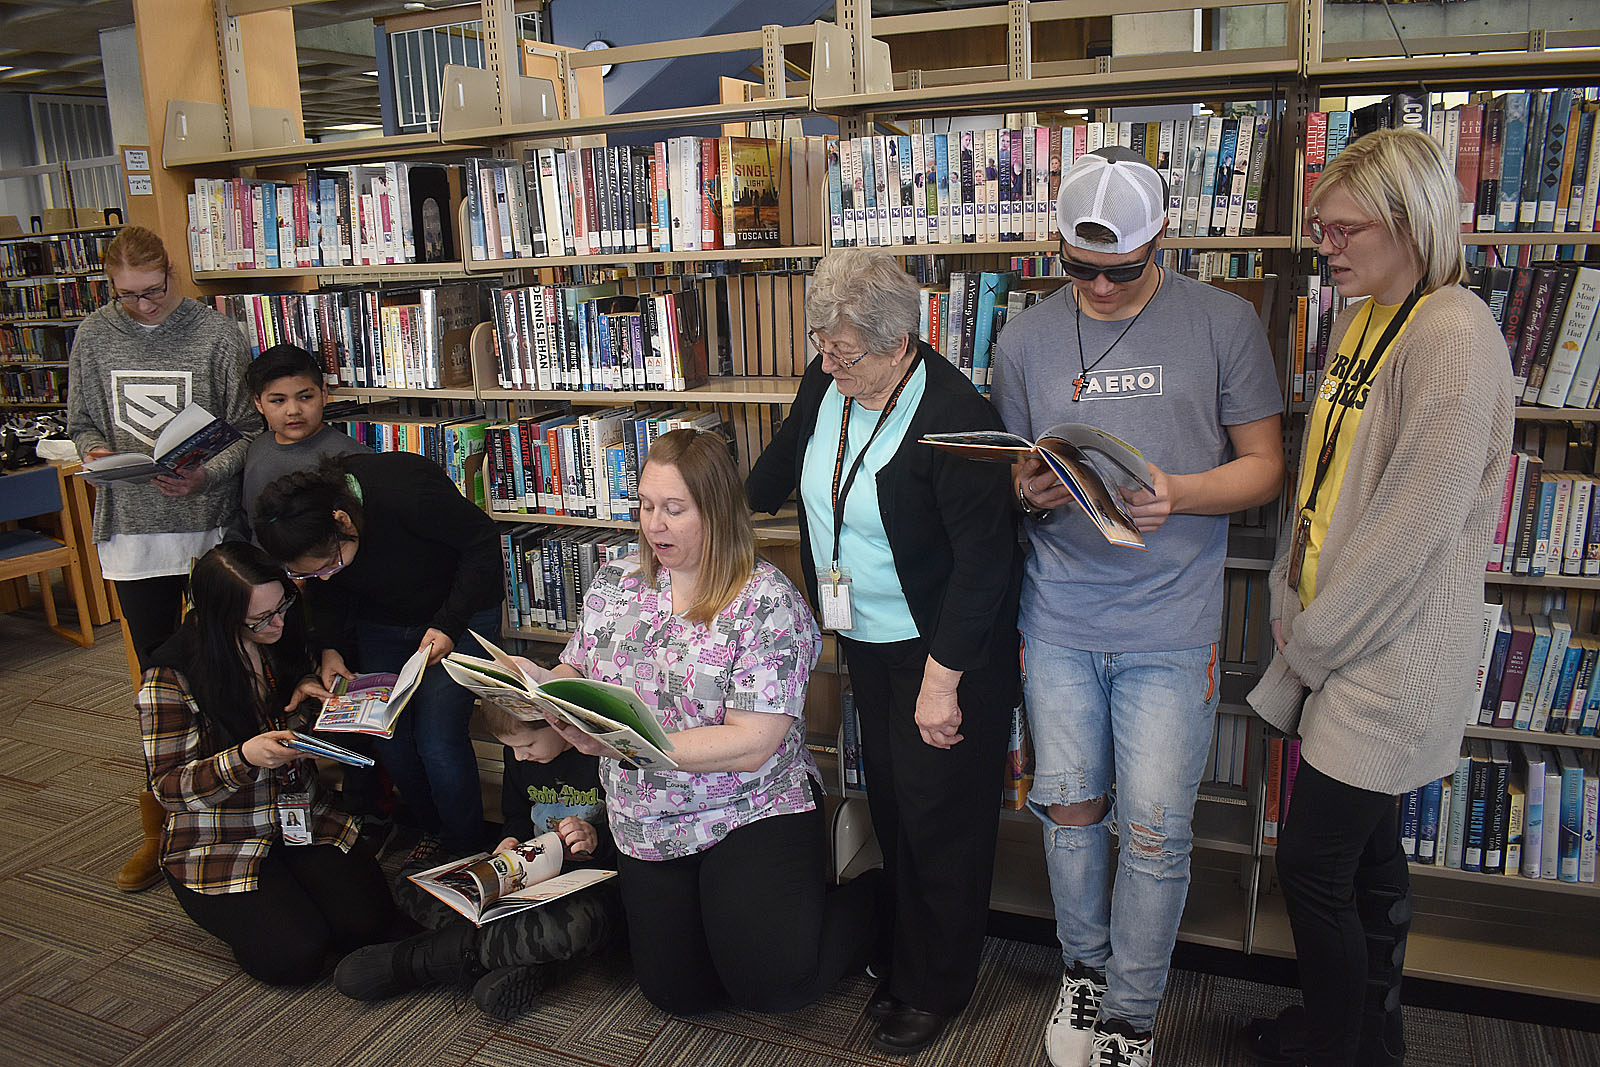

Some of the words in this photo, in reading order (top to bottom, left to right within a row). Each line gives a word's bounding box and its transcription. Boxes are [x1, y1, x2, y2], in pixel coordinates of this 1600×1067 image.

[1307, 125, 1317, 156] LITTLE
[1316, 120, 1326, 160] BENTLEY
[1328, 128, 1337, 158] LITTLE
[622, 148, 630, 173] HARPER
[721, 147, 729, 182] SINGLE
[735, 165, 776, 177] SINGLE
[1254, 152, 1262, 168] Stone
[634, 165, 643, 203] Mockingbird
[746, 179, 765, 187] LIGHT
[737, 232, 762, 241] TOSCA
[764, 231, 778, 240] LEE
[1518, 271, 1529, 287] 29
[1537, 283, 1548, 295] The
[1558, 282, 1568, 295] THE
[1581, 283, 1596, 292] The
[533, 287, 545, 329] DENNIS
[965, 287, 975, 316] Young
[1575, 301, 1591, 311] Fun
[1576, 292, 1596, 302] Most
[248, 308, 256, 327] wife's
[932, 316, 937, 324] OF
[1506, 290, 1526, 351] SECONDS
[1548, 297, 1563, 329] WARTIME
[1574, 311, 1587, 321] We
[965, 318, 973, 337] Wife
[1566, 329, 1583, 339] Had
[1568, 320, 1587, 330] Ever
[536, 332, 548, 369] LEHAN
[1524, 333, 1537, 351] House
[1540, 330, 1553, 358] SISTERS
[1086, 372, 1155, 394] AERO
[124, 384, 177, 431] S
[885, 396, 898, 415] Schools
[841, 409, 849, 429] Schools
[503, 436, 511, 456] SEARCH
[520, 425, 531, 467] LEMAITRE
[495, 447, 504, 470] NEIGHBORS
[505, 457, 513, 473] PARTY
[505, 473, 514, 489] SIMON
[523, 470, 533, 493] ALEX
[584, 468, 593, 479] GET
[627, 470, 638, 499] KILLSHOT
[1528, 487, 1537, 510] SUMMER
[1524, 513, 1533, 530] KERRY
[1543, 505, 1551, 517] ONES
[1574, 523, 1582, 537] CAN'T
[1520, 531, 1530, 557] LONSDALE
[504, 551, 512, 598] WOMAN
[604, 566, 622, 576] Hope
[620, 643, 638, 655] Hope
[668, 640, 688, 649] Courage
[1547, 655, 1560, 682] GENTLEMEN
[1584, 662, 1592, 686] MERLENE
[617, 784, 634, 796] Hope
[665, 780, 690, 789] Courage
[1479, 767, 1487, 798] ELIZABETH
[1496, 768, 1506, 802] RUNNING
[1570, 773, 1579, 803] ELIZABETH
[560, 784, 598, 806] Hood
[1408, 789, 1418, 816] TARGET
[1453, 811, 1463, 835] perfect
[1470, 800, 1486, 832] INNOCENT
[1493, 803, 1502, 832] SCARED
[1509, 805, 1518, 837] LOWELL
[1568, 804, 1577, 828] LOWELL
[1468, 835, 1480, 846] AS
